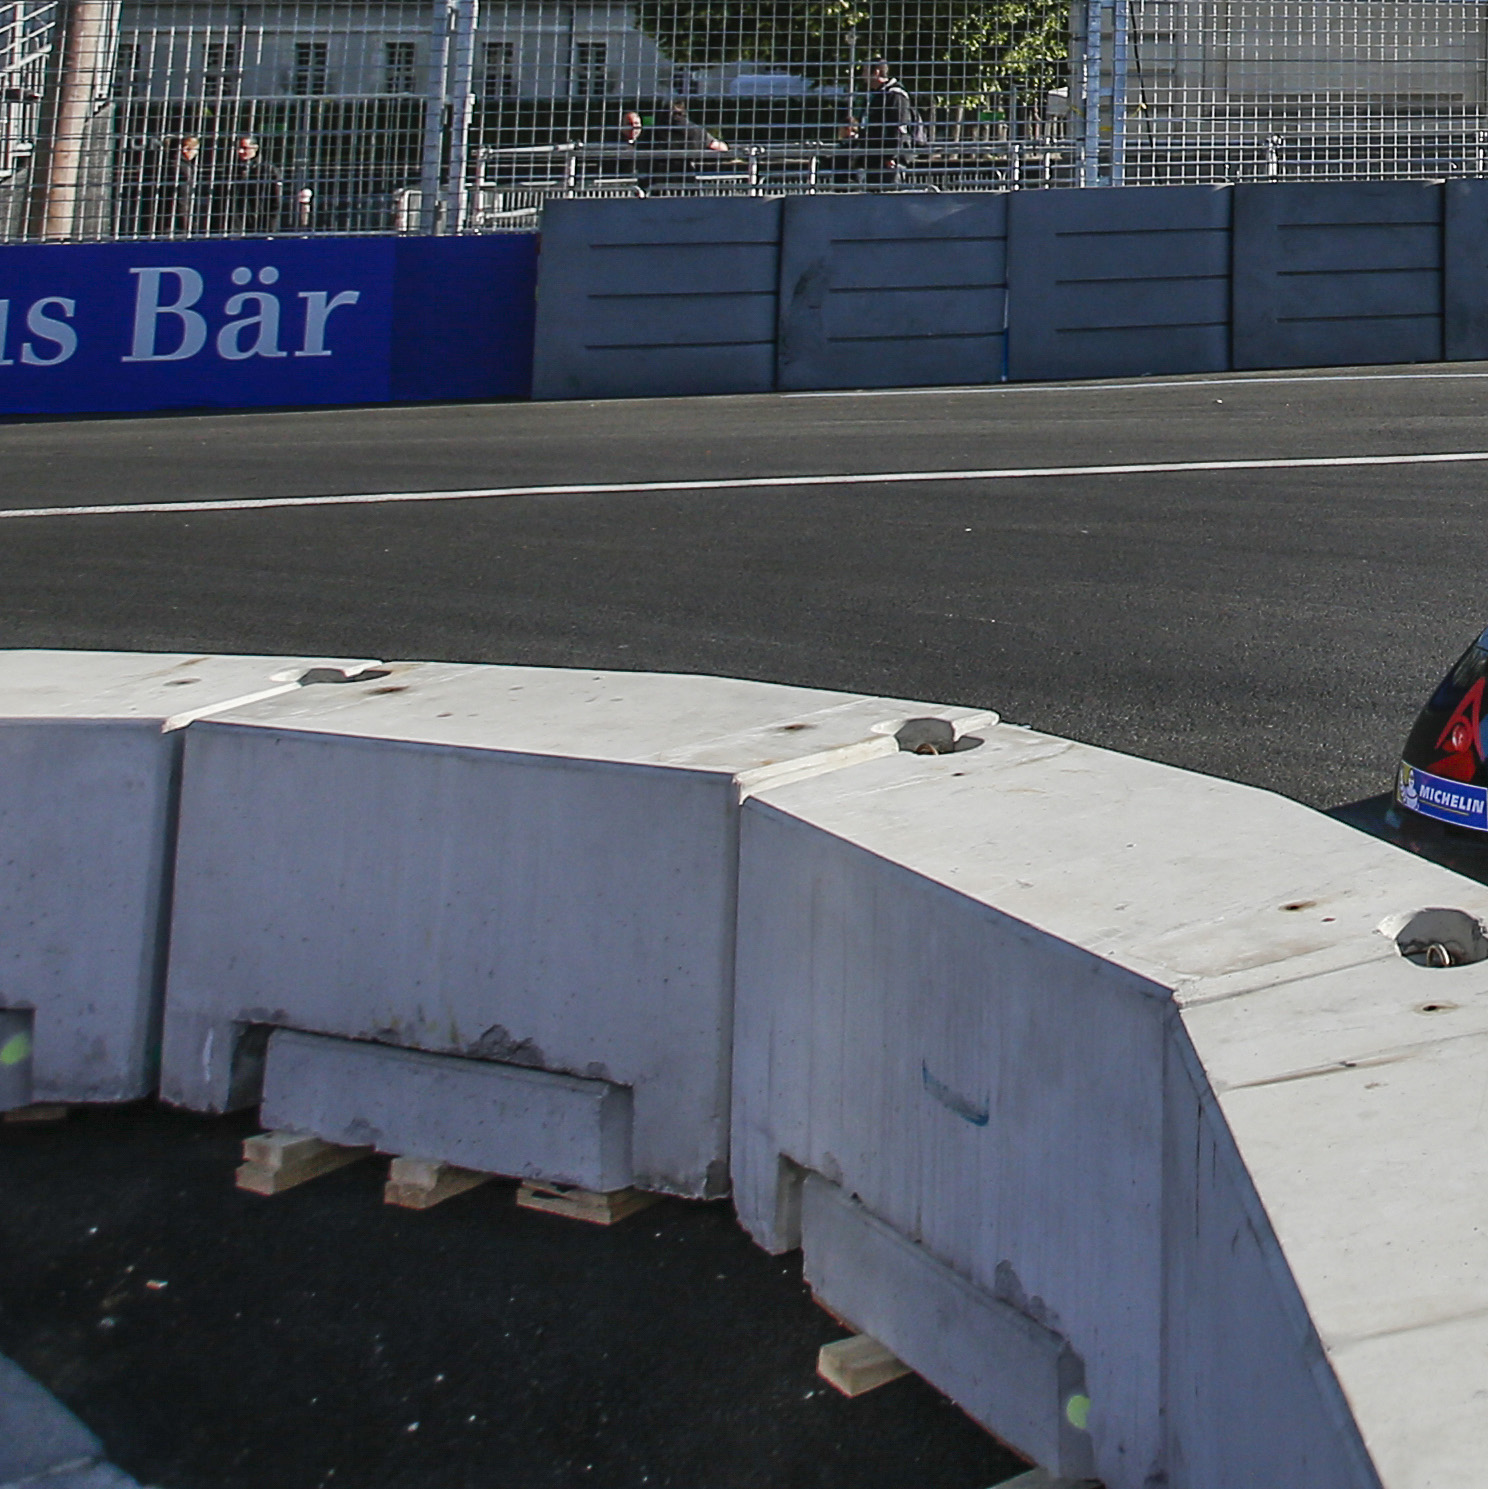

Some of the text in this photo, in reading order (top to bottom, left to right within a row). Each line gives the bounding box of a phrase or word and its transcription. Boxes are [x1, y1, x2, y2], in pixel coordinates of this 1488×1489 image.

[0, 266, 361, 366] s Bär
[1419, 783, 1485, 814] MICHELIN
